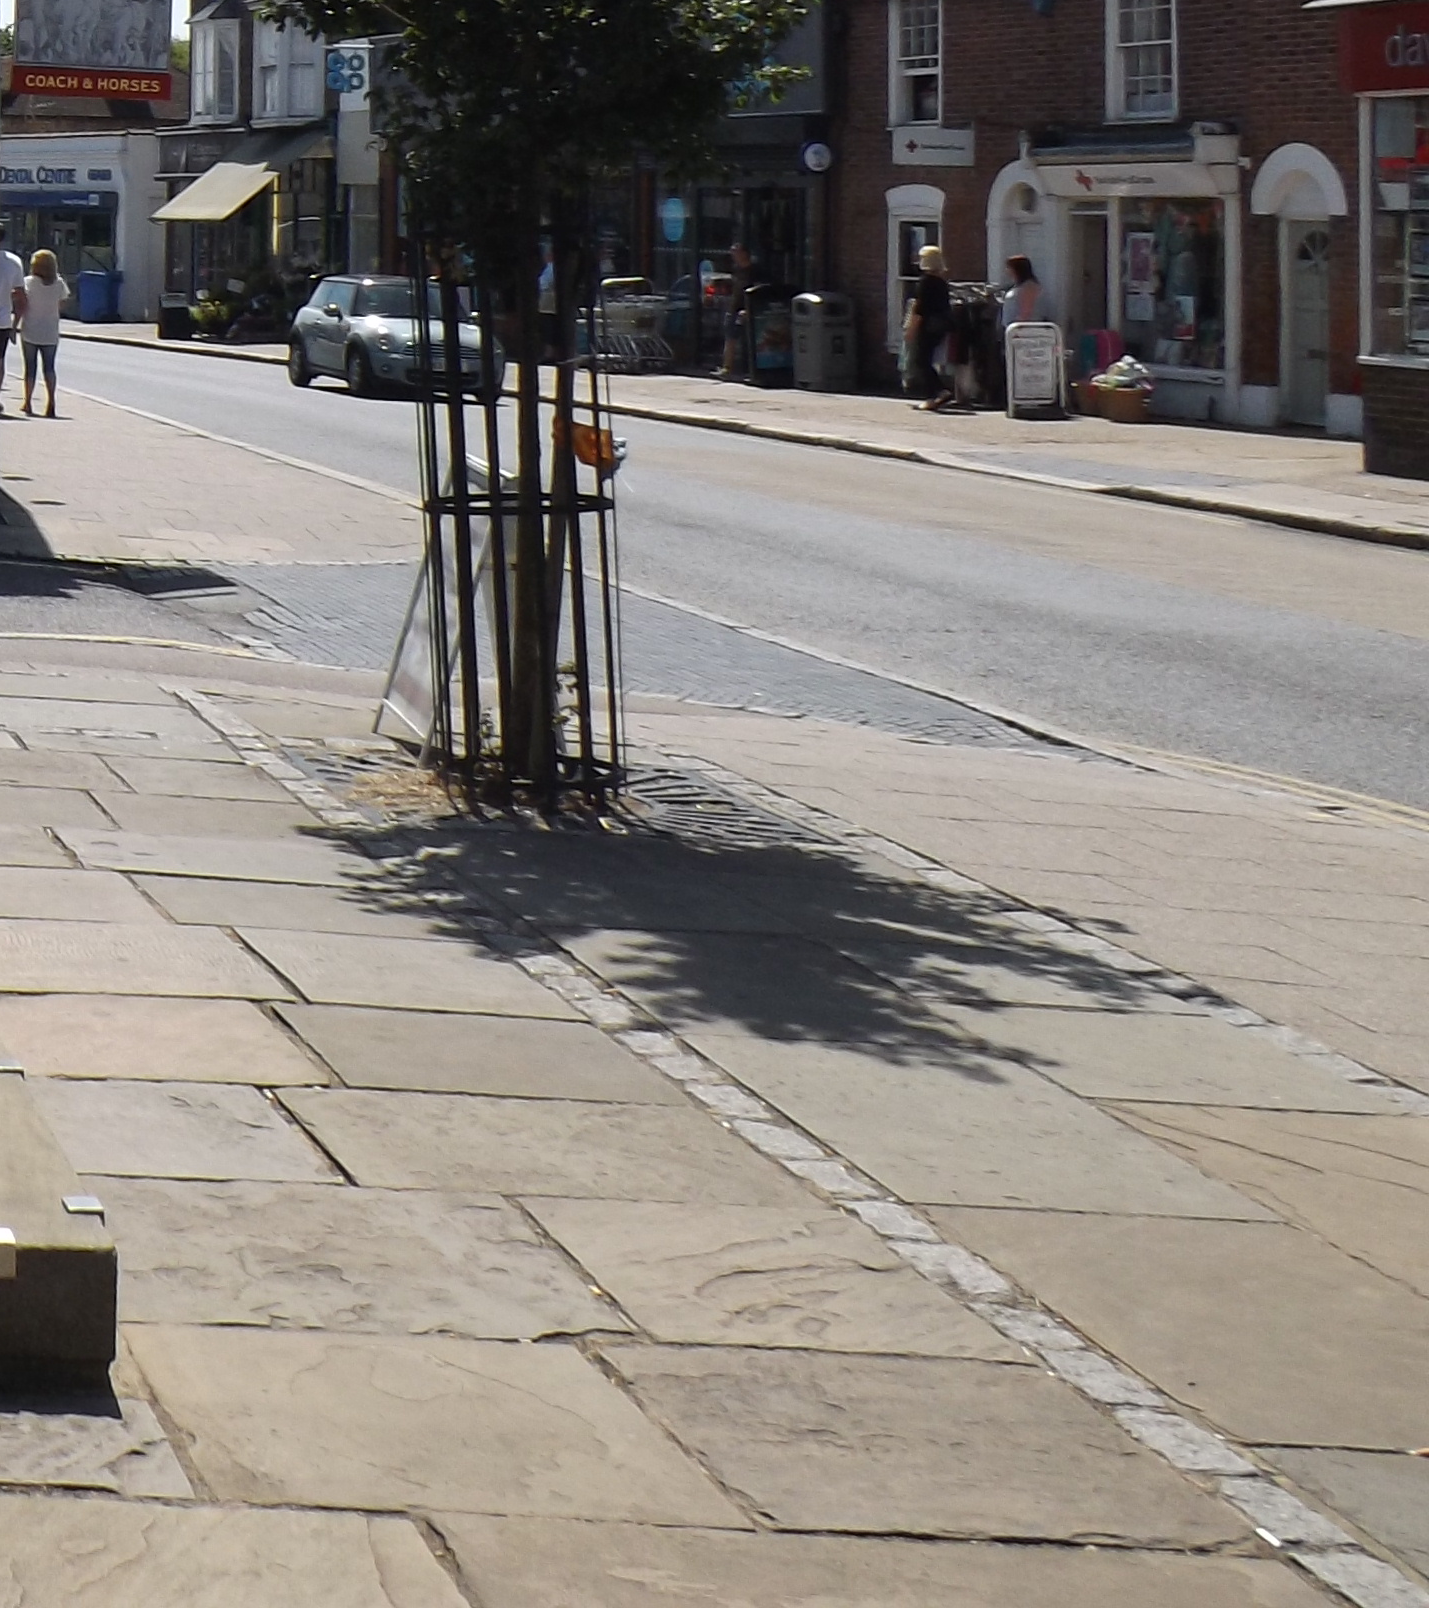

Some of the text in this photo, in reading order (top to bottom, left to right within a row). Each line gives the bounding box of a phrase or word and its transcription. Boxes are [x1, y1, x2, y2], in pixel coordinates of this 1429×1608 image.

[1385, 24, 1429, 66] da
[25, 74, 162, 93] COACH & HORSES
